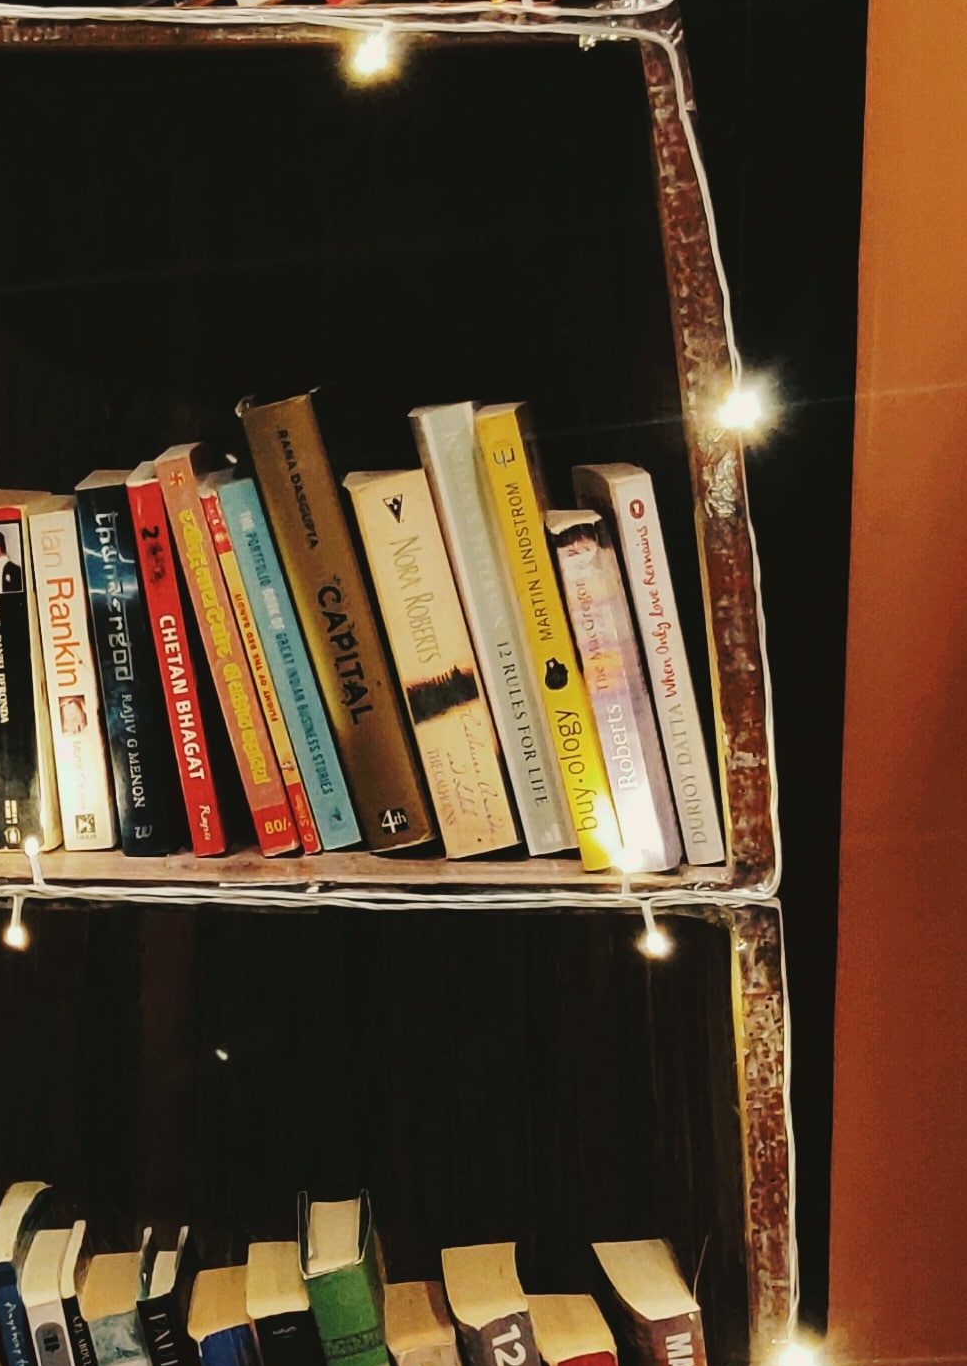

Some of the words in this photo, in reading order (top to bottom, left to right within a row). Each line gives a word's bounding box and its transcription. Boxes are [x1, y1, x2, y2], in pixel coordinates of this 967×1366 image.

[278, 428, 297, 469] RANA
[290, 471, 320, 550] DASGUPTA
[40, 528, 64, 569] Ian
[506, 481, 540, 575] LINDSTROM
[389, 535, 422, 590] NORA
[636, 525, 655, 586] Remains
[95, 510, 134, 682] thundergod
[235, 593, 250, 628] BANDIT
[531, 578, 554, 642] MARTIN
[648, 589, 665, 618] Love
[46, 576, 83, 688] Rankin
[246, 630, 258, 651] RED
[404, 592, 441, 665] ROBERTS
[497, 641, 513, 660] 12
[655, 620, 672, 655] Only
[246, 532, 271, 586] PORTFOLIO
[276, 633, 294, 665] GREAT
[312, 754, 334, 796] STORIES
[252, 657, 263, 671] THE
[318, 584, 374, 726] CAPITAL
[596, 661, 609, 690] The
[660, 657, 678, 698] When
[120, 694, 137, 734] RAJIV
[159, 614, 189, 695] CHETAN
[175, 699, 206, 781] BHAGAT
[263, 690, 278, 723] FLIGHT
[502, 662, 527, 722] RULES
[127, 738, 138, 750] G
[517, 724, 538, 764] FOR
[612, 703, 637, 790] Roberts
[668, 703, 693, 765] DATTA
[128, 751, 146, 809] MENON
[527, 767, 551, 807] LIFE
[381, 808, 408, 834] 4th
[680, 771, 707, 846] DURJOY
[77, 1338, 90, 1366] ABDUL
